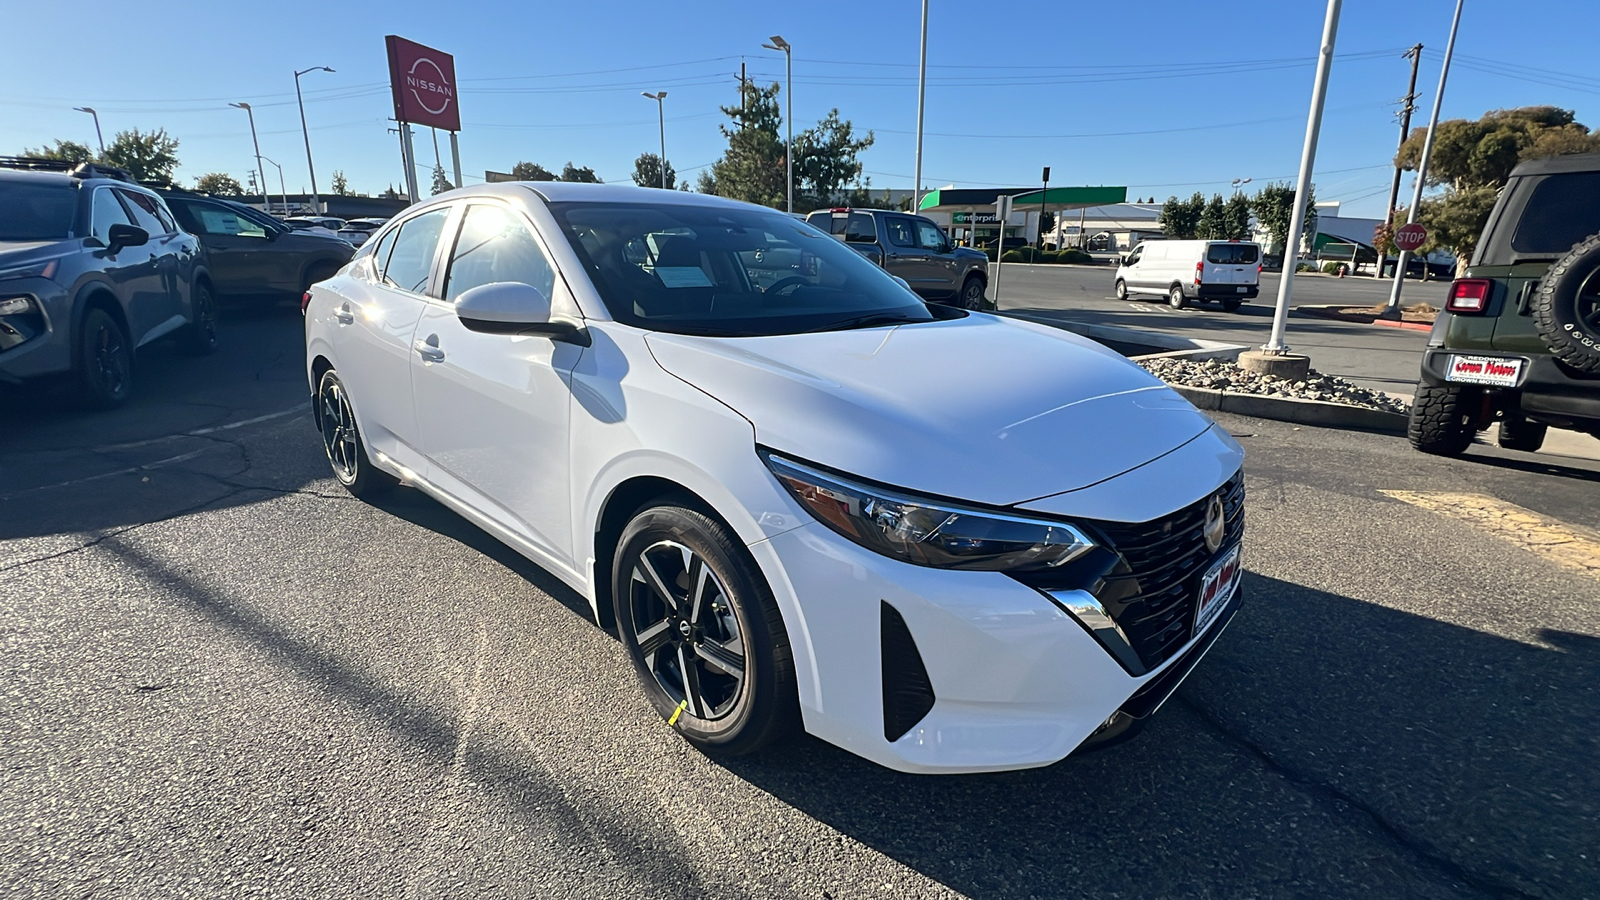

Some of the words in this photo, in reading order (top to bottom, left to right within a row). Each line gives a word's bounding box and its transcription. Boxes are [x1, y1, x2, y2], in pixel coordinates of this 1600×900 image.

[407, 76, 452, 96] NISSAN
[1397, 232, 1425, 243] STOP
[1455, 361, 1483, 374] Crown
[1484, 361, 1517, 376] Motors
